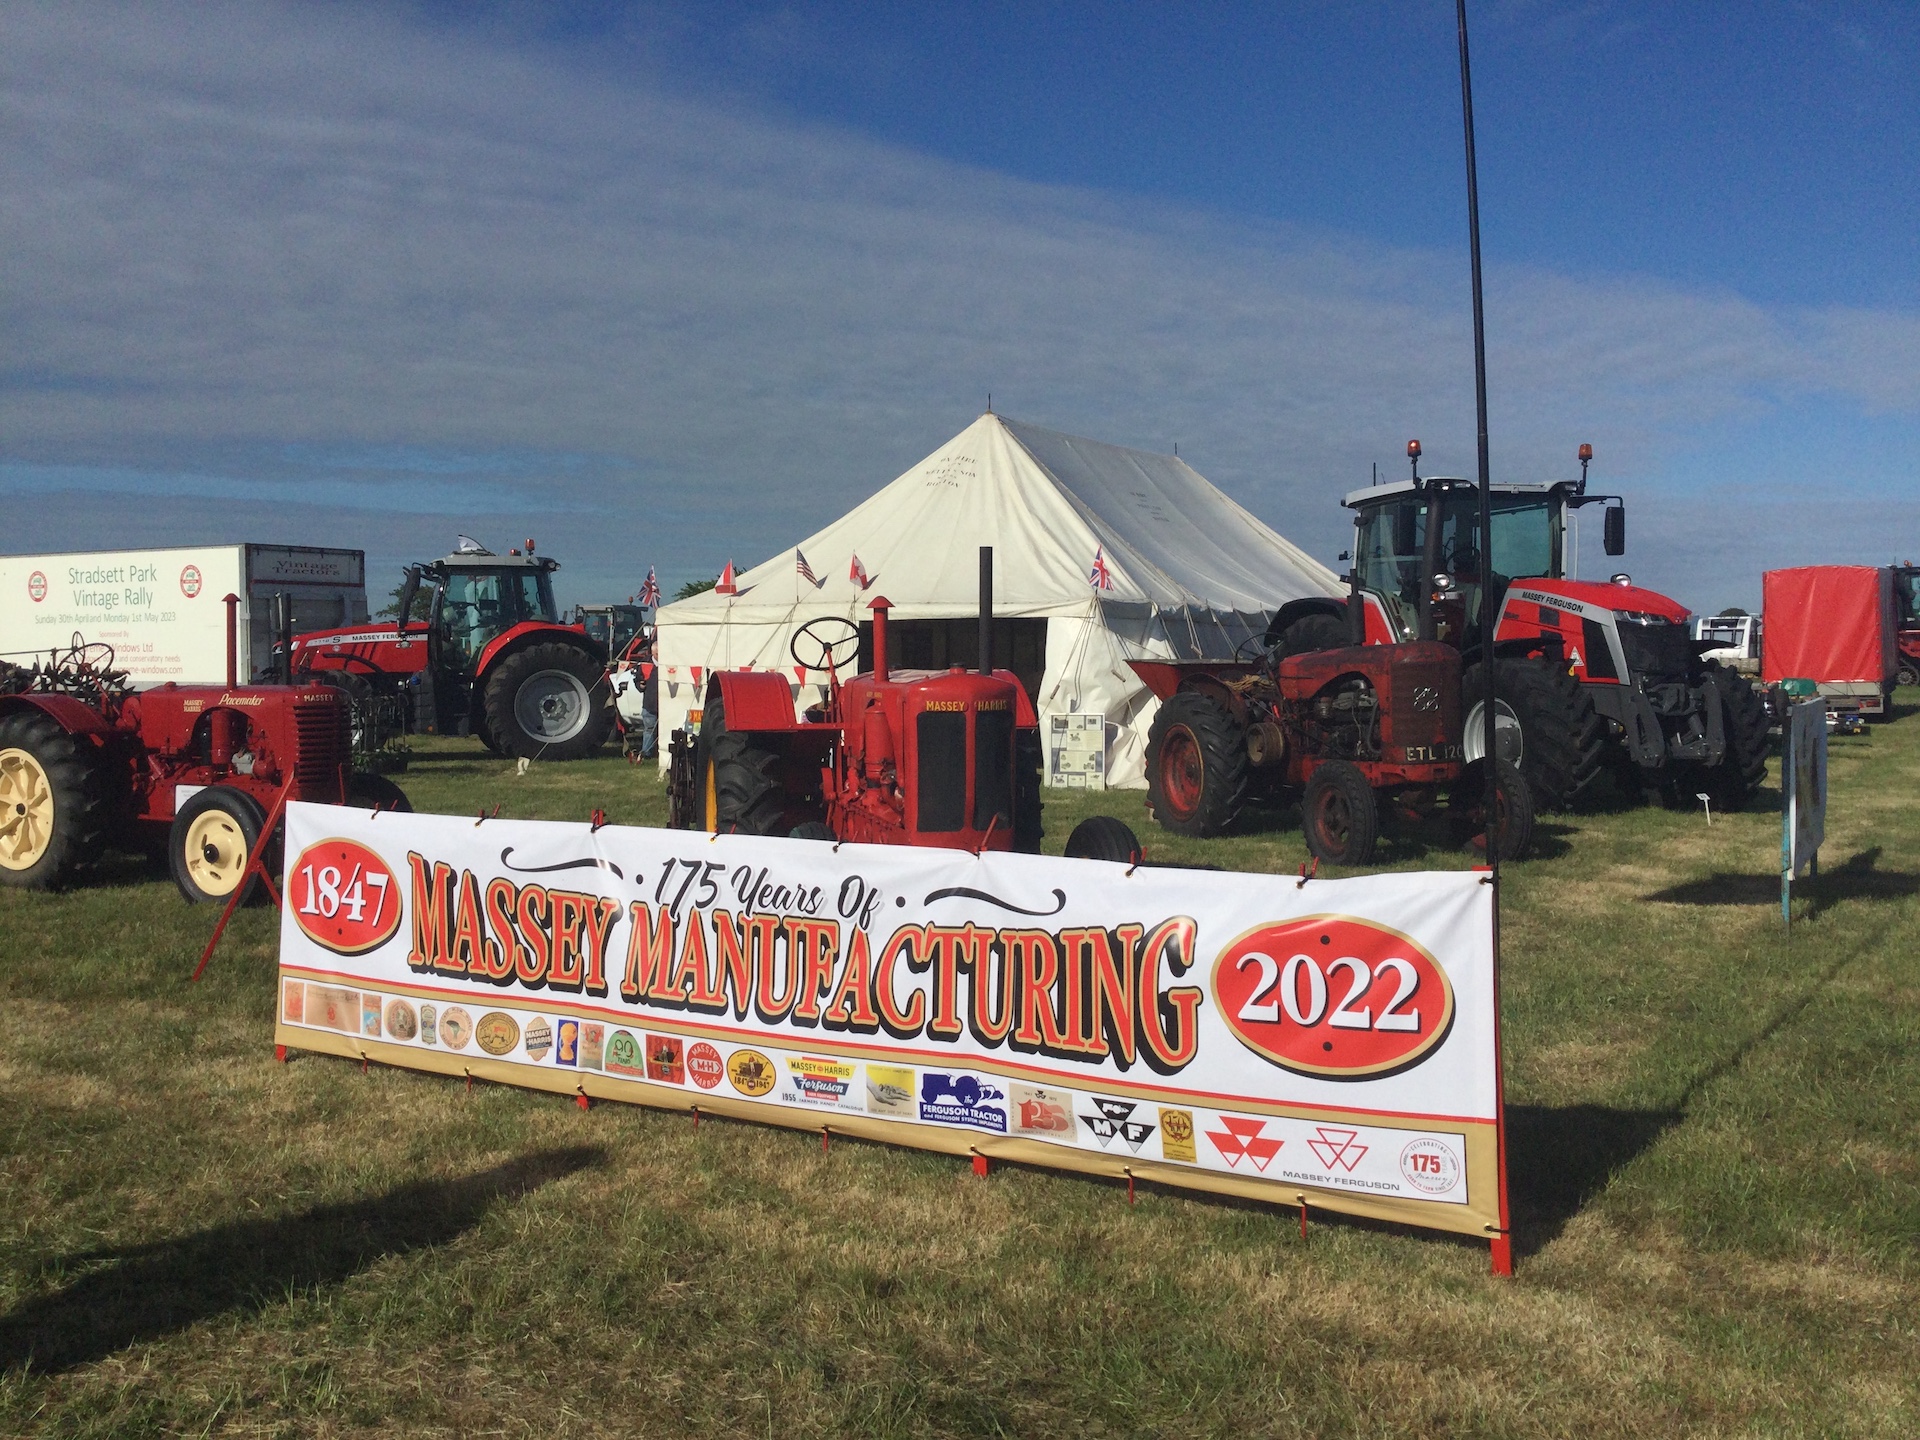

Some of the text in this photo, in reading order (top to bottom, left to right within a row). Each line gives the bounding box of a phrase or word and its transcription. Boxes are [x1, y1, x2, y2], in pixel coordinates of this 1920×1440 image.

[272, 566, 341, 576] Tractors
[276, 560, 338, 570] Vintage
[68, 563, 157, 585] Stradsett Park
[73, 587, 153, 610] Vintage Rally
[1521, 591, 1584, 613] MASSEY FERGUSON
[35, 614, 57, 625] Sunday
[58, 613, 73, 624] 30th
[104, 613, 130, 624] Monday
[132, 612, 142, 623] 1st
[144, 612, 159, 624] May
[160, 611, 176, 622] 2023
[142, 643, 154, 653] Ltd
[218, 693, 265, 706] Pacemaker
[926, 700, 1008, 712] MASSEY HARRIS
[1406, 746, 1437, 761] ETL
[300, 861, 390, 929] 1847
[655, 857, 881, 932] 175 Years Of
[407, 850, 1204, 1077] MASSEY MANUFACTURING
[1236, 951, 1421, 1034] 2022
[691, 1044, 718, 1059] MASSEY
[697, 1060, 714, 1072] M-H
[790, 1061, 850, 1077] MASSEY HARRIS
[693, 1073, 719, 1088] HARRIS
[798, 1077, 844, 1093] Ferguson
[782, 1092, 797, 1102] 1955
[922, 1104, 969, 1116] FERGUSON
[970, 1109, 1003, 1123] TRACTOR
[934, 1114, 960, 1122] FERGUSON
[1092, 1118, 1112, 1136] M
[1127, 1124, 1144, 1140] F
[1410, 1153, 1441, 1173] 175
[1282, 1170, 1400, 1191] MASSEY FERGUSON
